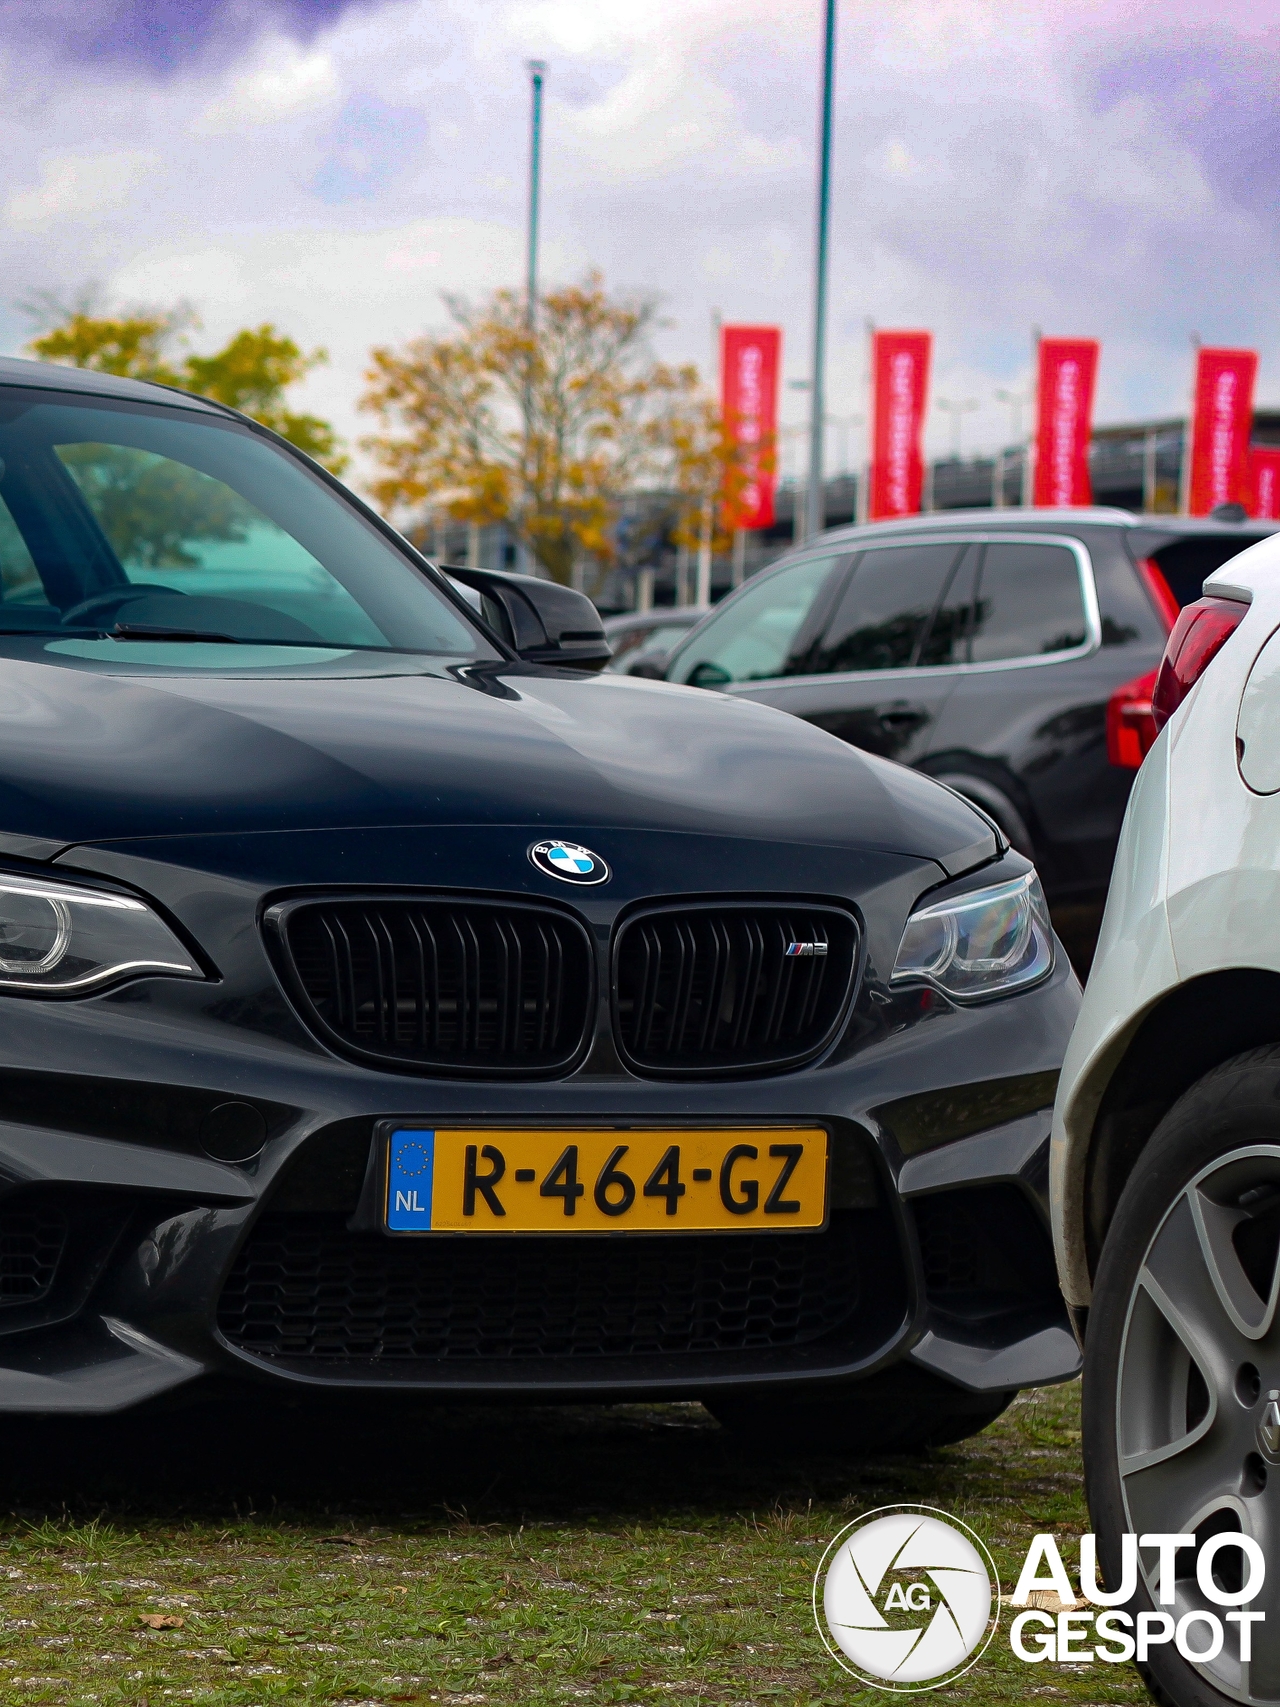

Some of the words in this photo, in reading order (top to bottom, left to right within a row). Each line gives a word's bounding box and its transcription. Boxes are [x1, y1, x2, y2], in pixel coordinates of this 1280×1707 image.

[535, 840, 592, 854] BMW
[798, 942, 828, 956] M2
[462, 1143, 804, 1217] R-464-GZ
[395, 1190, 425, 1212] NL
